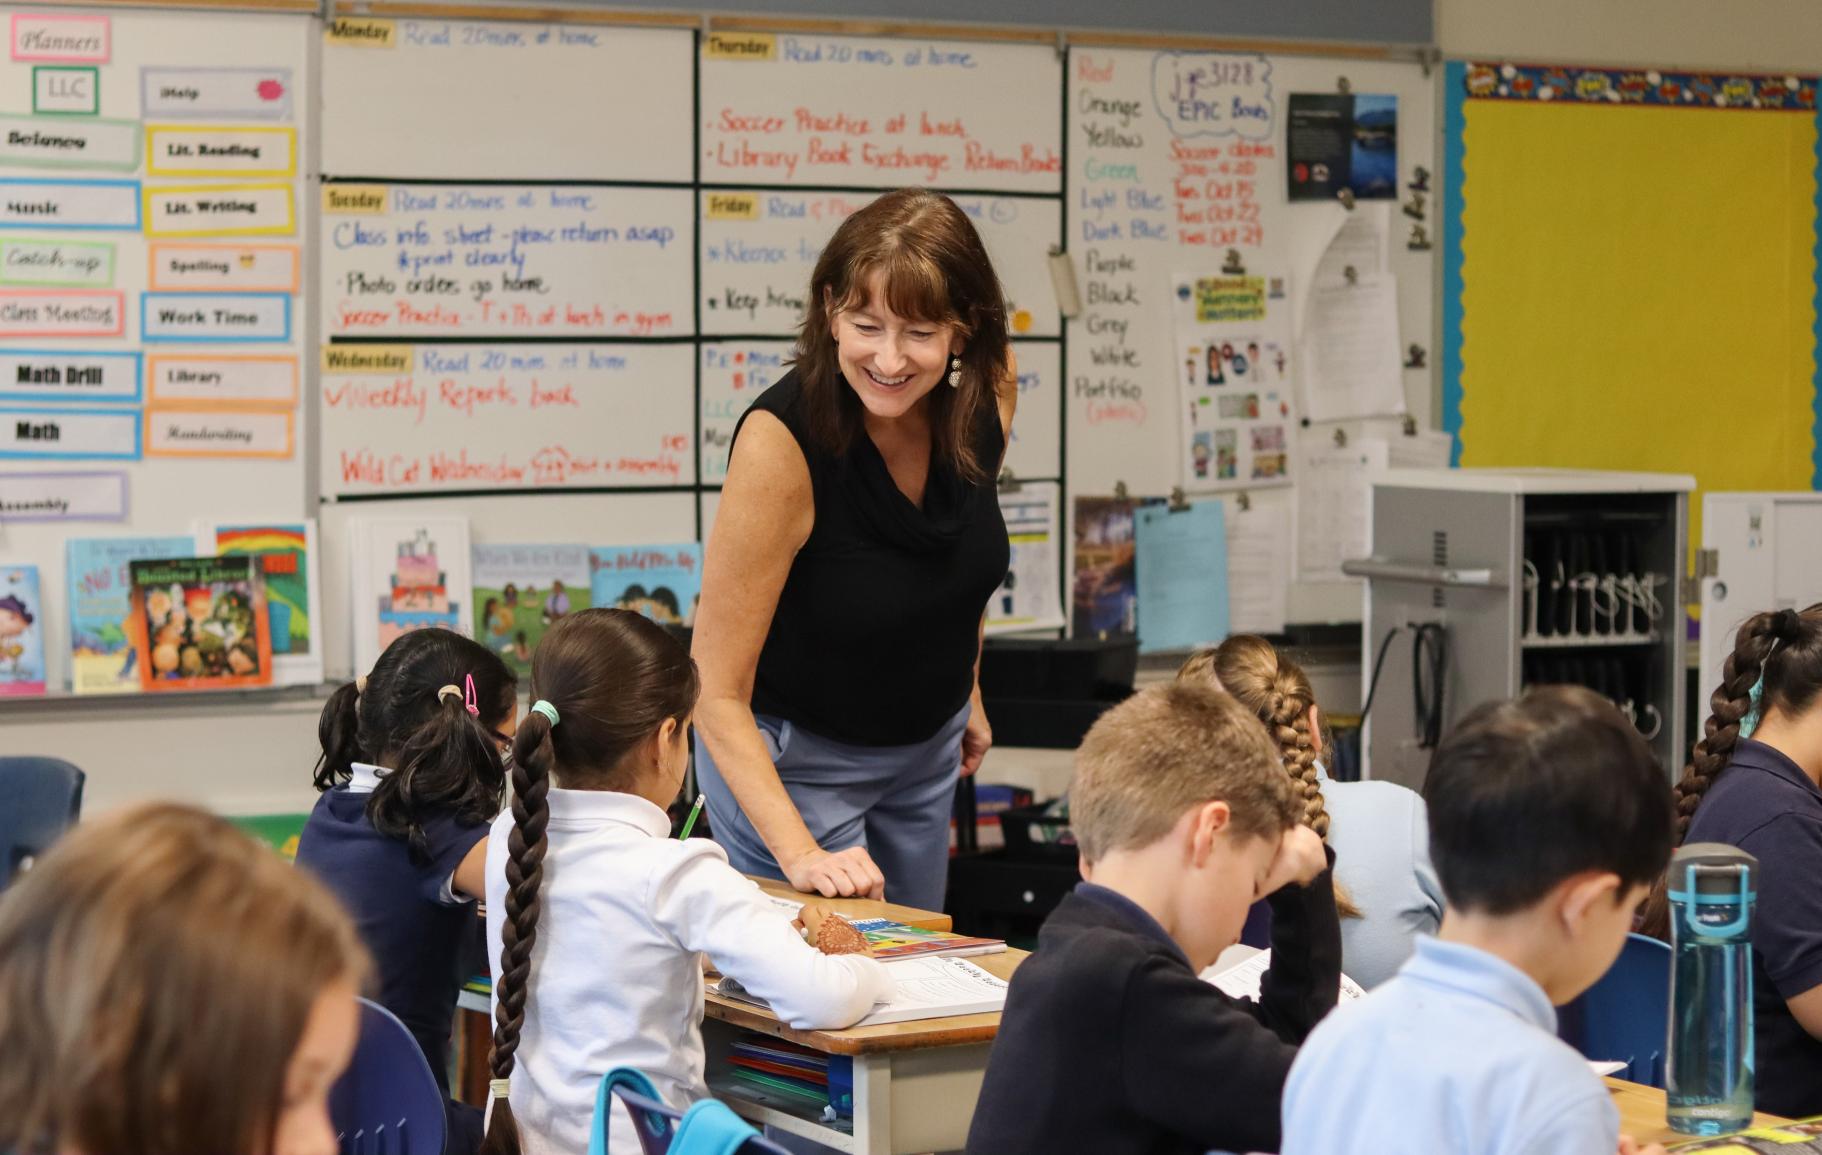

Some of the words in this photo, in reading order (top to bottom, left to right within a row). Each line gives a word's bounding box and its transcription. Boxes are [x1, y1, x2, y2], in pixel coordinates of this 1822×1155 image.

[22, 28, 100, 50] Planners
[330, 21, 390, 42] Monday
[403, 23, 450, 45] Read
[710, 37, 770, 57] Thursday
[784, 39, 822, 63] Read
[1078, 57, 1116, 82] Red
[48, 78, 86, 98] LLC
[1078, 92, 1143, 127] Orange
[720, 108, 784, 133] Soccer
[795, 107, 872, 136] Practice
[885, 113, 906, 133] at
[1081, 122, 1144, 150] Yellow
[198, 144, 260, 158] Reading
[717, 141, 798, 178] Library
[807, 138, 851, 165] Book
[861, 142, 950, 181] Exchange
[1085, 157, 1142, 181] Green
[197, 200, 258, 215] Writing
[328, 190, 384, 210] Tuesday
[394, 190, 437, 211] Read
[711, 197, 752, 215] Friday
[767, 196, 806, 218] Read
[1126, 189, 1165, 212] Blue
[333, 222, 388, 250] Class
[444, 222, 493, 245] sheet
[561, 221, 619, 244] return
[626, 224, 675, 250] asap
[1083, 219, 1123, 242] Dark
[1130, 218, 1170, 241] Blue
[5, 249, 101, 273] Catch-up
[170, 260, 230, 274] Spelling
[413, 250, 455, 277] print
[465, 246, 527, 279] clearly
[1086, 250, 1136, 275] Purple
[347, 271, 396, 295] Photo
[470, 279, 493, 302] go
[501, 271, 550, 295] home
[1087, 281, 1140, 306] Black
[2, 304, 38, 323] Class
[46, 303, 114, 325] Meeting
[726, 288, 759, 318] Keep
[159, 310, 206, 324] Work
[213, 310, 258, 325] Time
[332, 300, 390, 330] Soccer
[394, 300, 461, 328] Practice
[1086, 316, 1129, 344] Grey
[326, 350, 407, 370] Wednesday
[422, 350, 469, 373] Read
[480, 351, 506, 370] 20
[1090, 348, 1141, 368] White
[16, 365, 60, 385] Math
[66, 365, 103, 386] Drill
[168, 369, 222, 386] Library
[438, 378, 518, 417] Reports
[16, 422, 60, 441] Math
[167, 425, 253, 443] Handwriting
[340, 450, 386, 486] Wild
[389, 452, 420, 485] Cat
